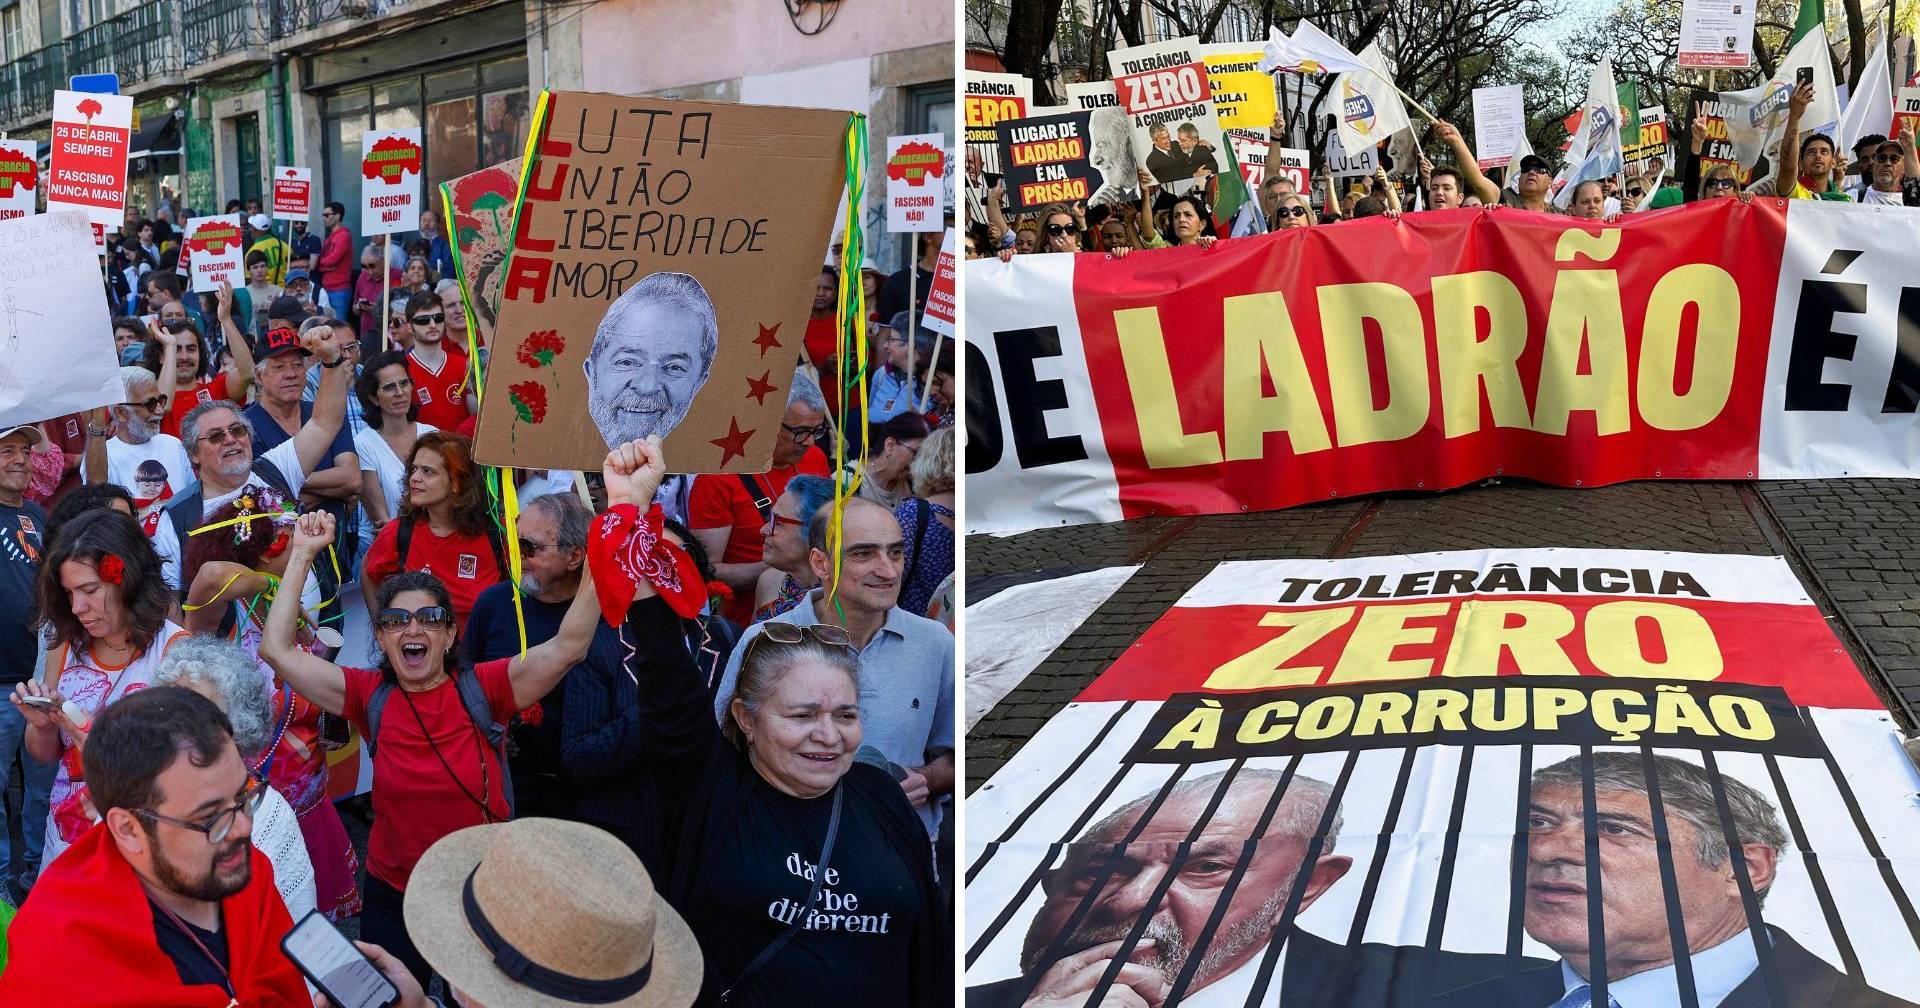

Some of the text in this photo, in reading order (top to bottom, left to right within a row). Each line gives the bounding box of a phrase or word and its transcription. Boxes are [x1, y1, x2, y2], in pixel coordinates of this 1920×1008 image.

[1121, 51, 1192, 75] TOLERÂNCIA
[1124, 67, 1201, 112] ZERO
[1143, 103, 1207, 126] CORRUPÇÃO
[57, 126, 122, 143] 25 DE ABRIL
[537, 92, 713, 159] LUTA
[1010, 121, 1078, 144] LUGAR DE
[63, 142, 113, 157] SEMPRE!
[367, 148, 416, 162] DEMOCRACIA
[891, 153, 939, 165] DEMOCRACIA
[1013, 138, 1081, 165] LADRÃO
[382, 164, 400, 176] SIM!
[1329, 152, 1371, 172] LULA
[58, 169, 114, 185] FASCISMO
[905, 168, 924, 179] SIM!
[1035, 164, 1068, 182] É NA
[51, 183, 123, 202] NUNCA MAIS!
[527, 162, 692, 206] UNIÃO
[1023, 178, 1086, 205] PRISÃO
[370, 193, 411, 208] FASCISMO
[894, 196, 935, 207] FASCISMO
[382, 209, 401, 222] NÃO!
[906, 209, 925, 221] NÃO!
[513, 202, 769, 256] LIBERDADE
[199, 261, 236, 273] FASCISMO
[504, 258, 639, 304] AMOR
[1113, 228, 1742, 469] LADRÃO
[1784, 249, 1868, 411] É
[1279, 563, 1710, 604] TOLERÂNCIA
[1201, 600, 1724, 690] ZERO
[1155, 682, 1775, 750] À CORRUPÇÃO
[823, 888, 858, 911] be
